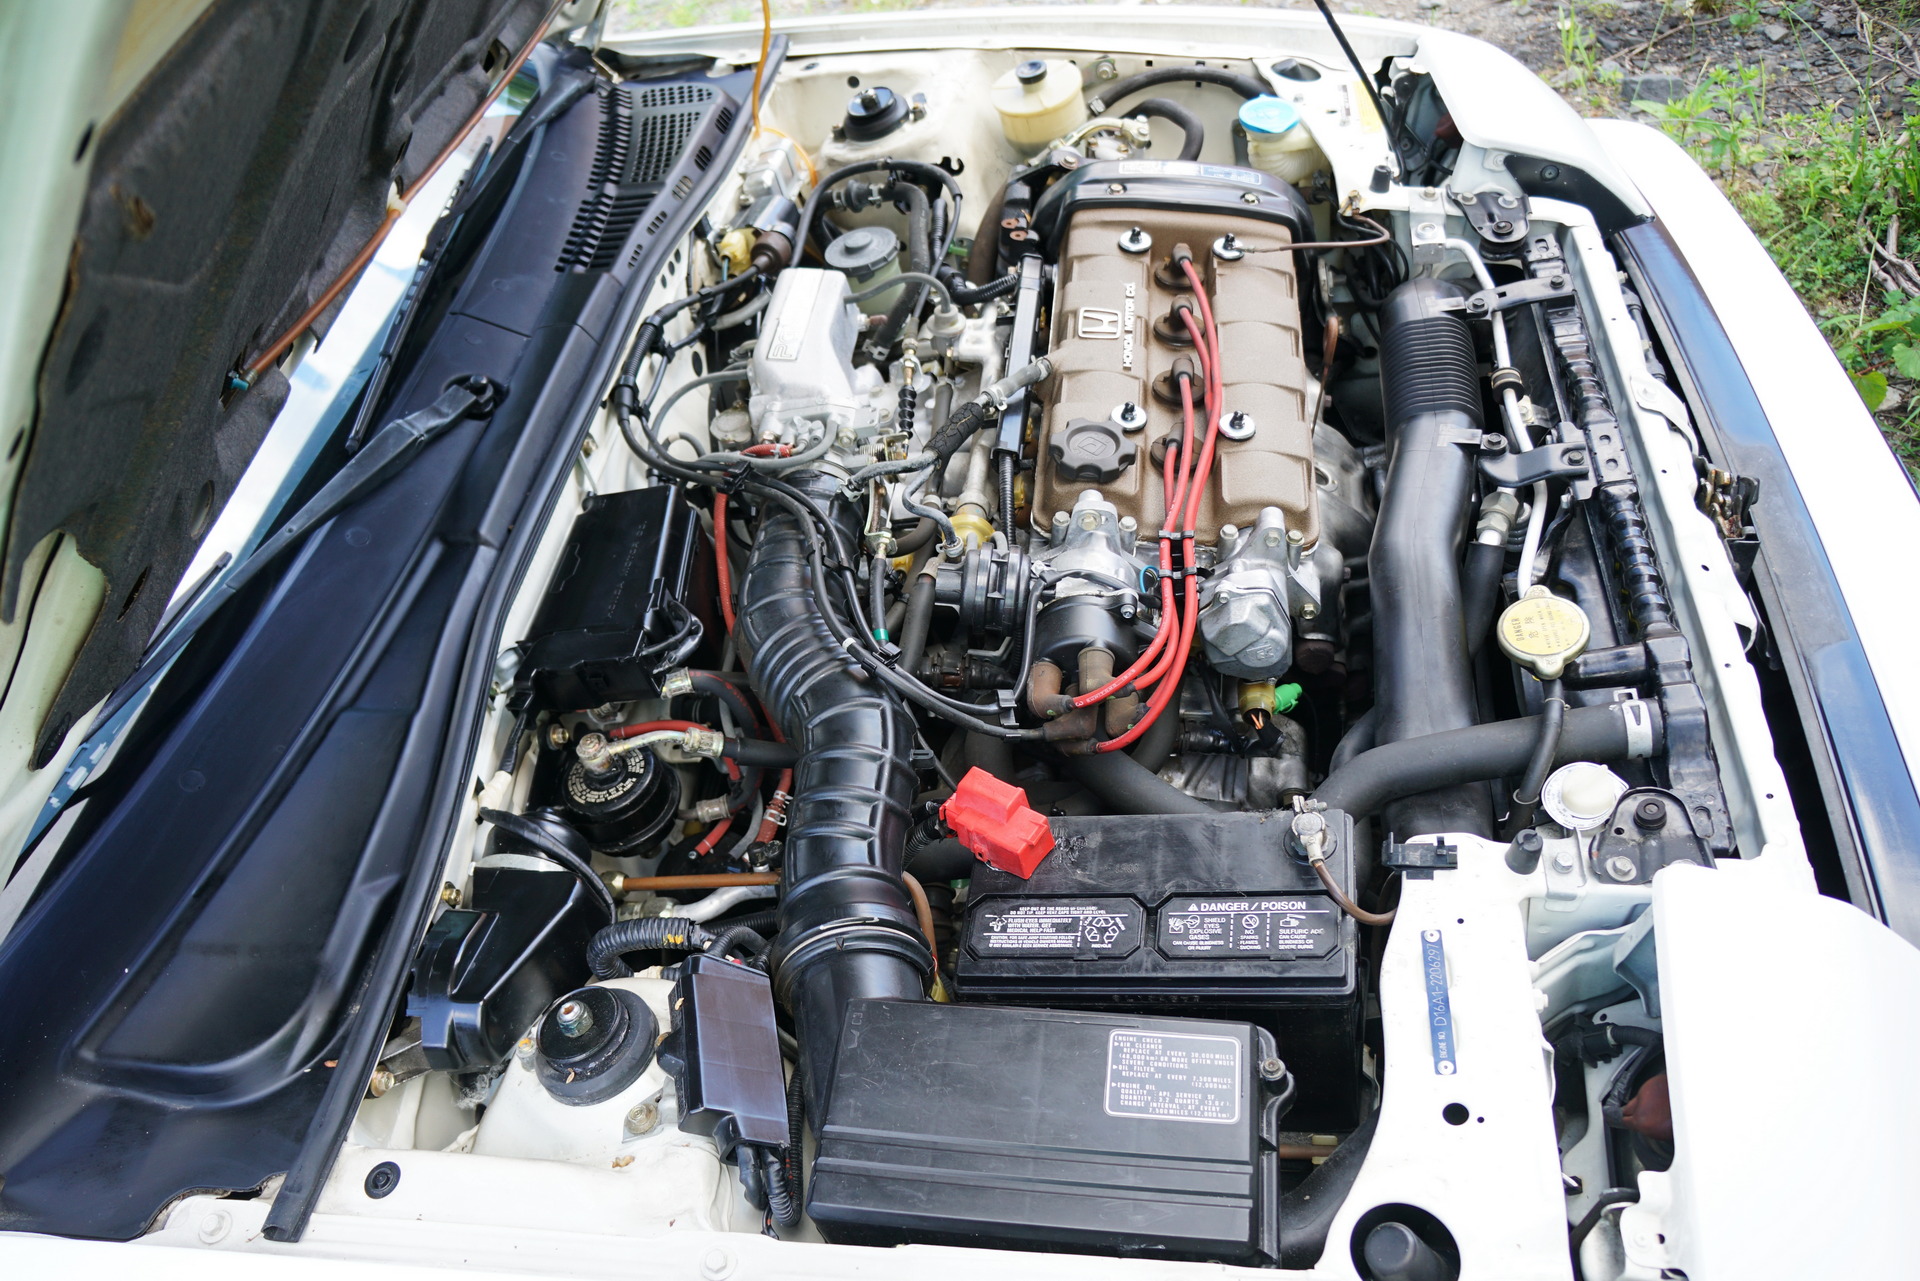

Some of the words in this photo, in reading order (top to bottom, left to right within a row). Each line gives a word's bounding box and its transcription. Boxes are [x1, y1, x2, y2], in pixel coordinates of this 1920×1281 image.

[1124, 299, 1135, 332] MOTOR
[1123, 332, 1133, 368] HONDA
[1200, 902, 1249, 911] DANGER
[1250, 902, 1259, 911] /
[1261, 901, 1307, 911] POISON
[1426, 943, 1448, 1027] D16A1-2206297
[1120, 1094, 1152, 1102] QUANTITY
[1175, 1092, 1202, 1100] SERVICE
[1150, 1102, 1180, 1110] INTERVAL
